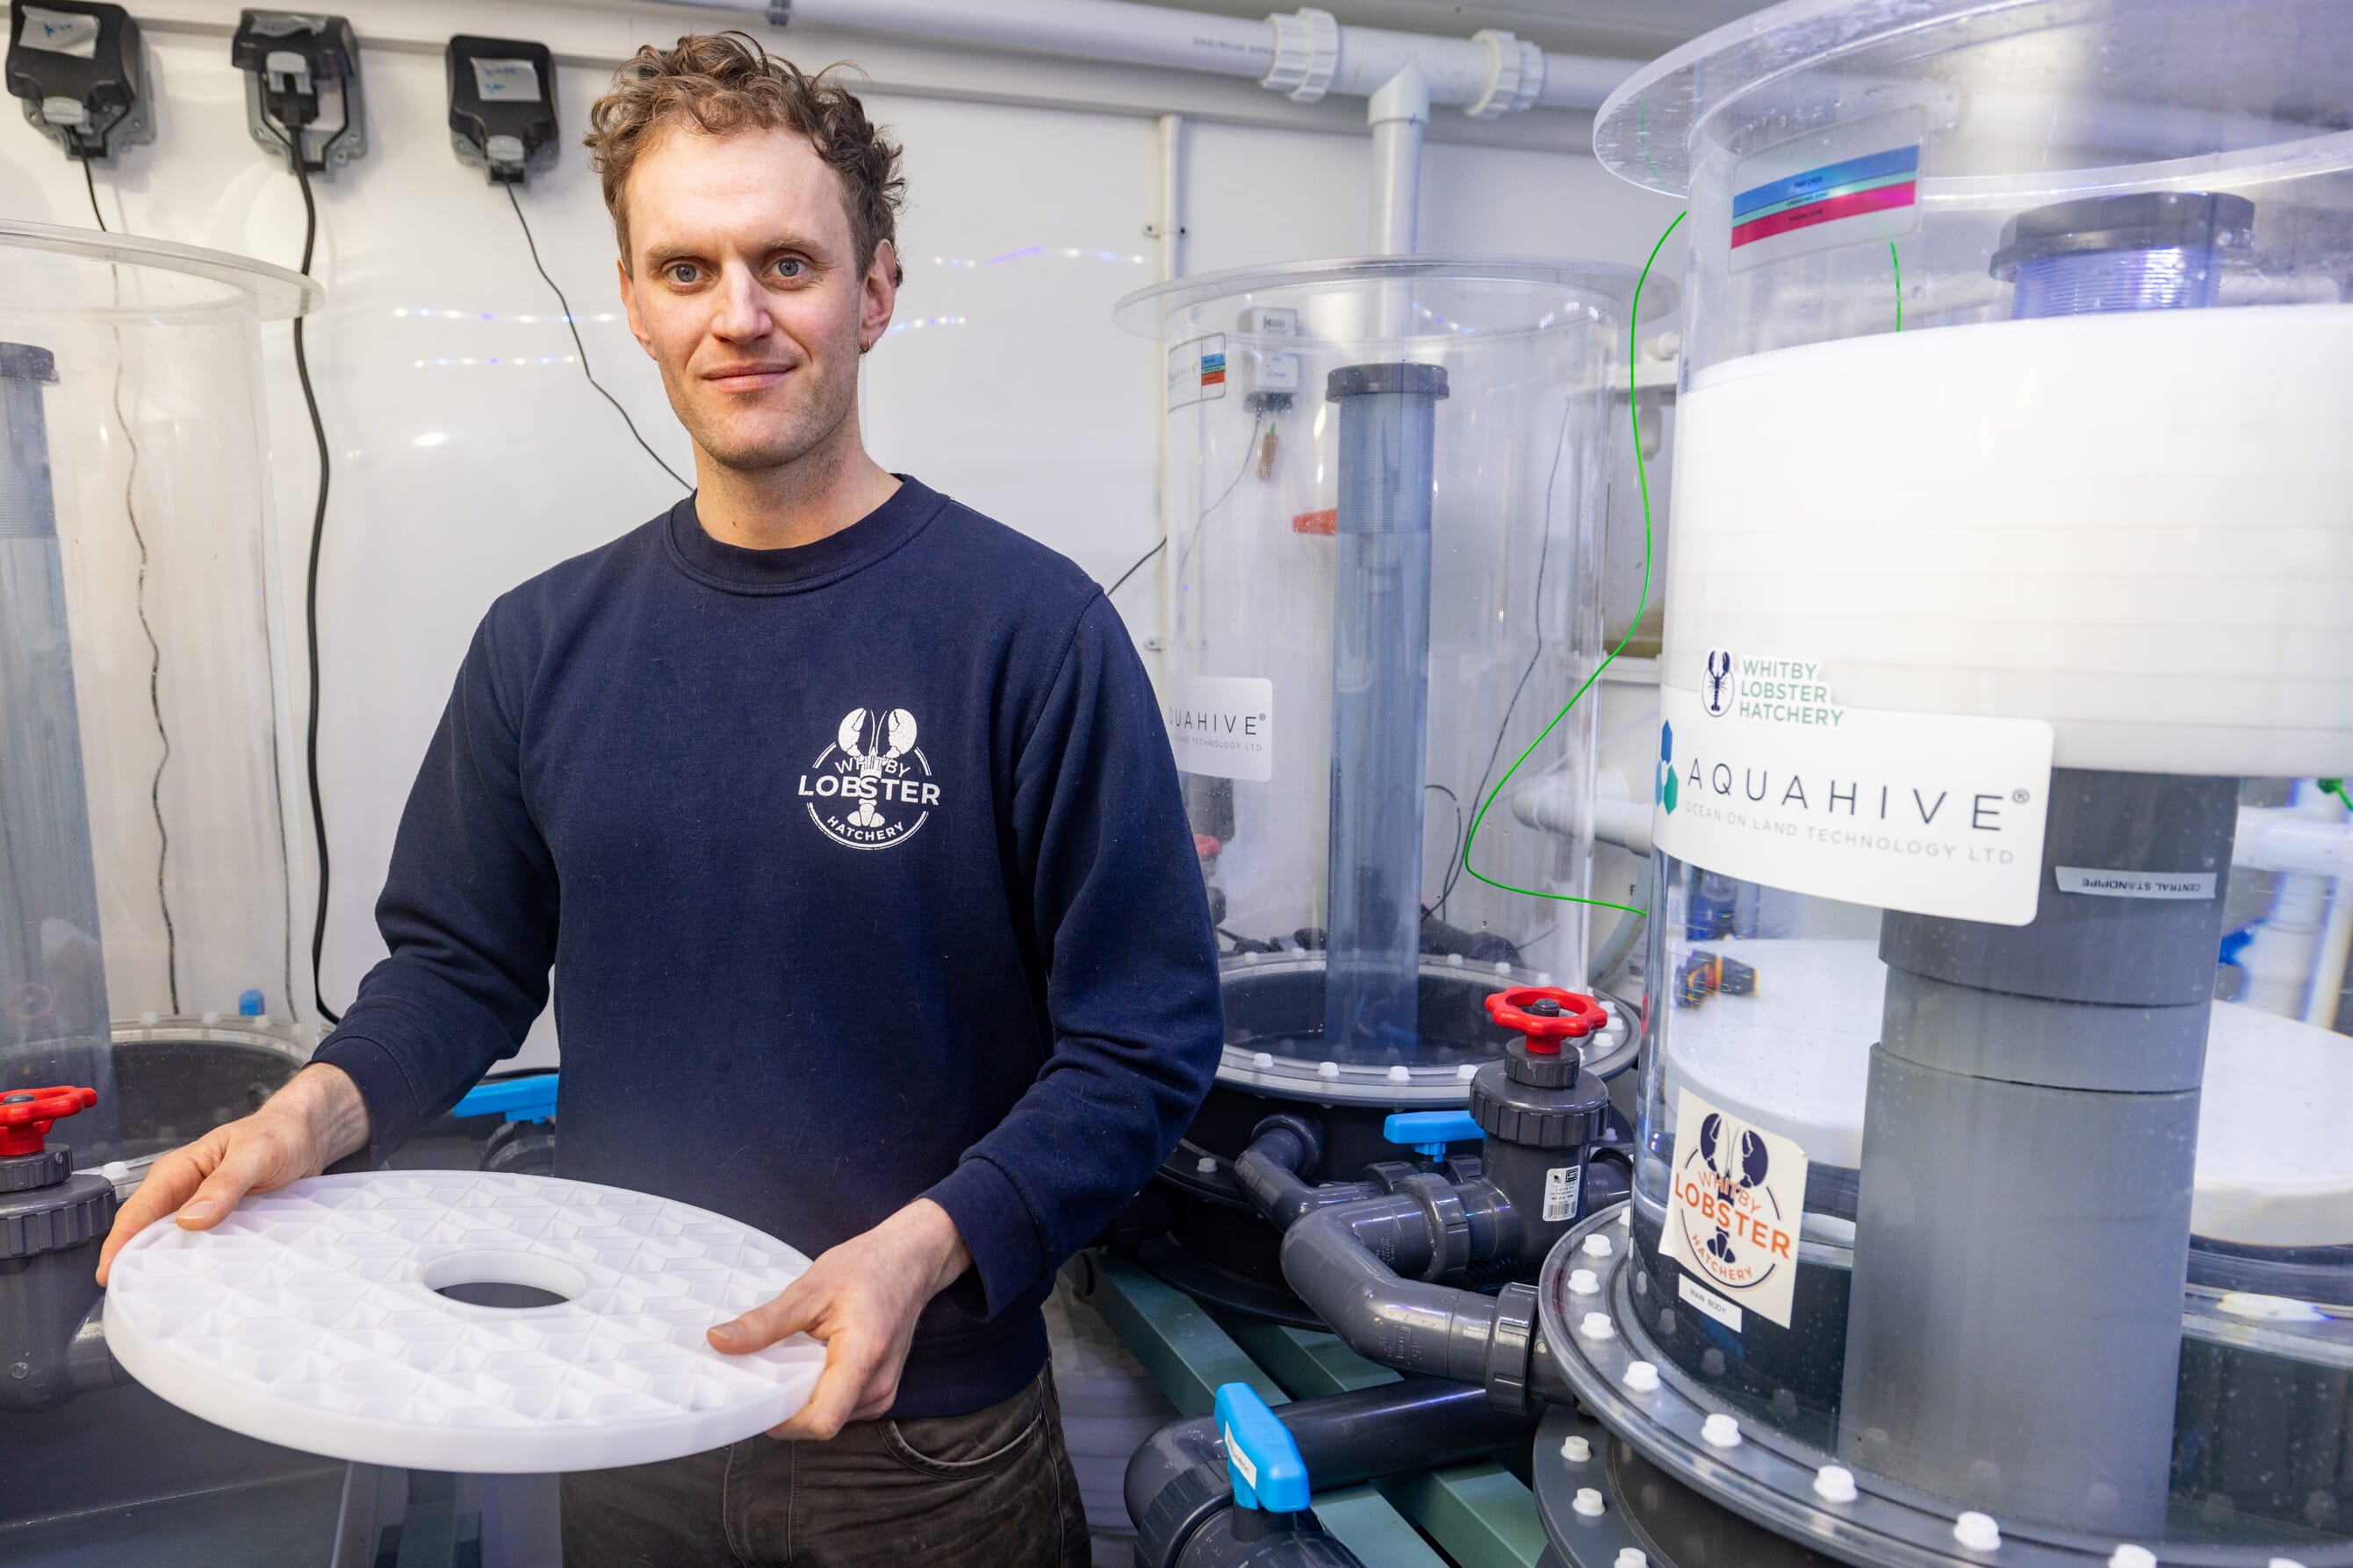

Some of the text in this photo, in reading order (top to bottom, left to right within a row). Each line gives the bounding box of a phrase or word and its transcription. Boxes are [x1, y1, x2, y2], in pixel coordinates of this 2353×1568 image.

[1743, 658, 1817, 680] WHITBY
[1740, 680, 1827, 703] LOBSTER
[1739, 701, 1845, 727] HATCHERY
[1245, 743, 1263, 752] LTD
[834, 755, 911, 778] WHITBY
[798, 774, 940, 806] LOBSTER
[827, 816, 903, 841] HATCHERY
[1685, 801, 2015, 865] OCEAN ON LAND TECHNOLOGY LTD
[2082, 878, 2202, 893] CENTRAL STANDPIPE
[1698, 1170, 1761, 1214] WHITBY
[1674, 1172, 1791, 1259] LOBSTER
[1692, 1234, 1753, 1281] HATCHERY
[1708, 1298, 1726, 1313] BODY
